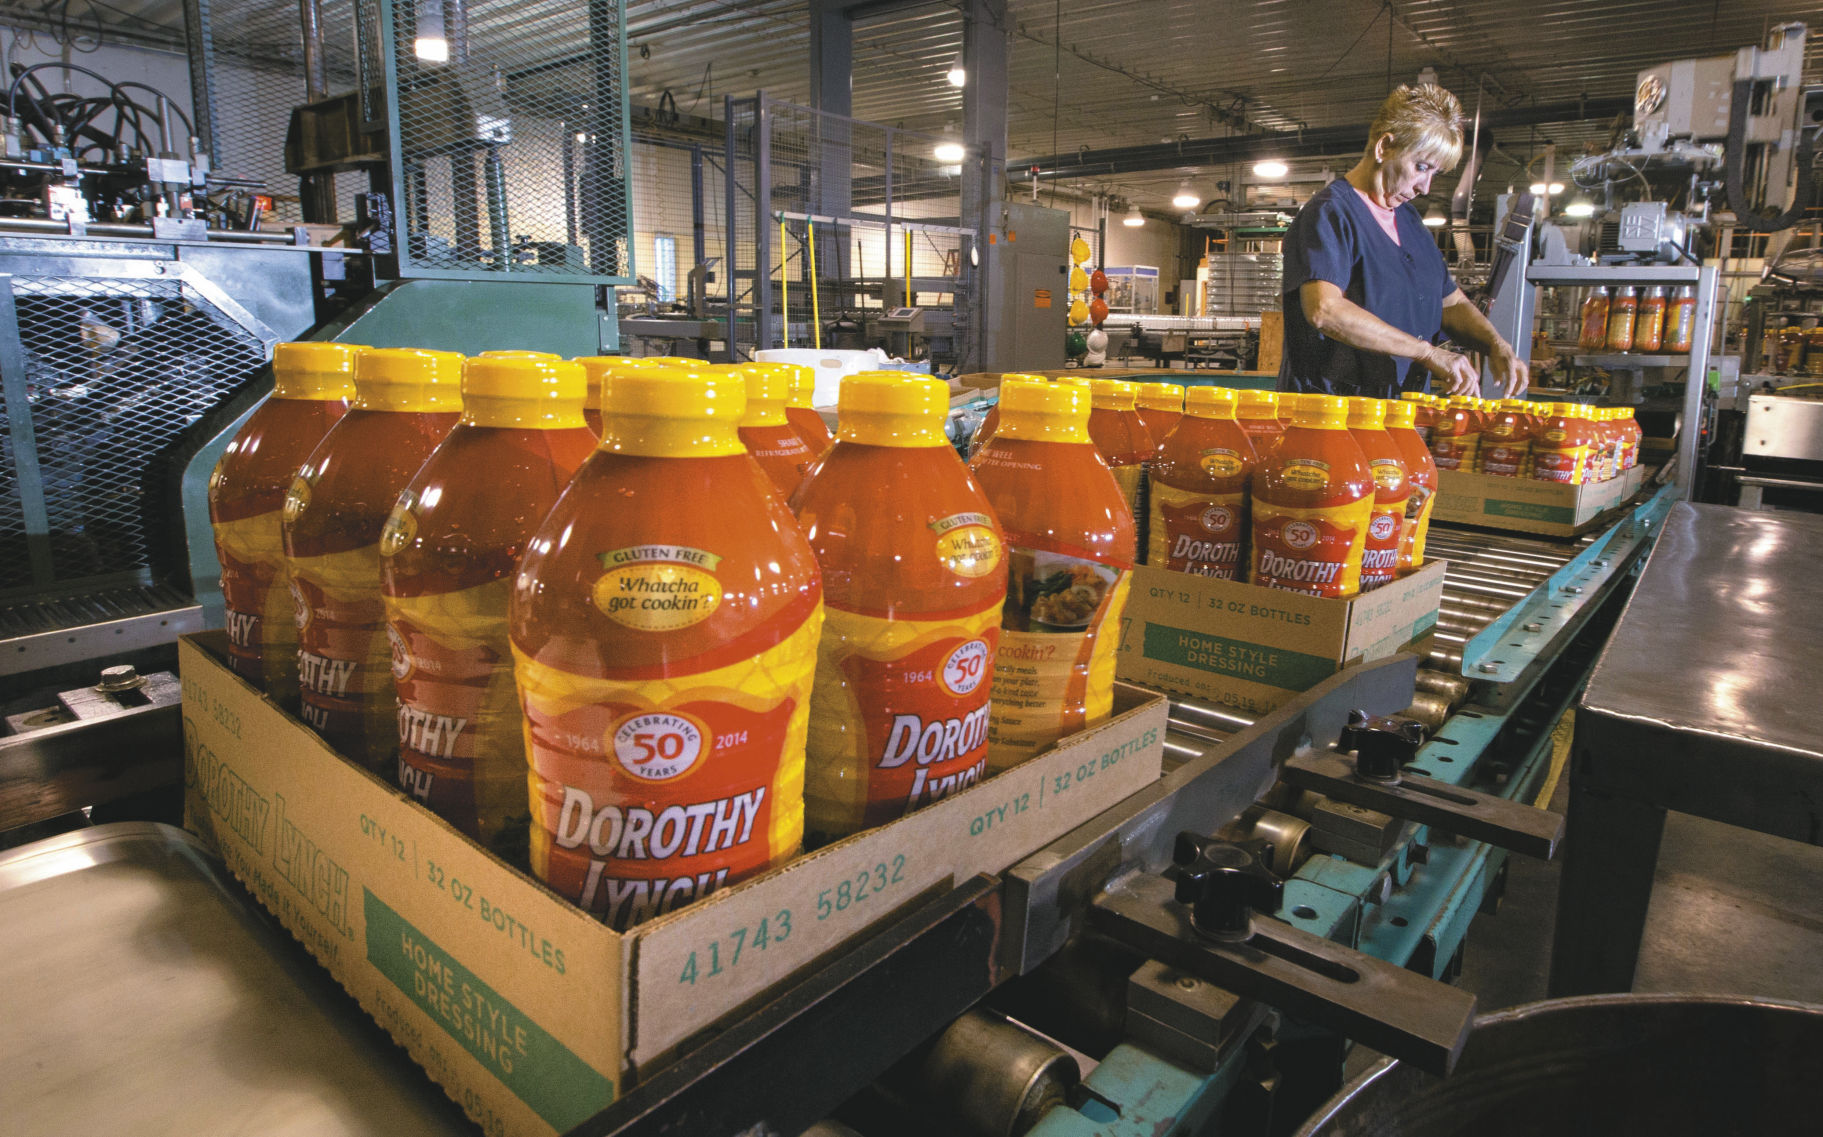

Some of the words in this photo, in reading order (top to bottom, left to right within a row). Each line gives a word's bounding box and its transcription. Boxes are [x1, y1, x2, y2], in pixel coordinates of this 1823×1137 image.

[940, 515, 973, 530] GLUTEN
[1209, 514, 1227, 526] 50
[1172, 534, 1240, 562] DOROTH
[1290, 529, 1310, 542] 50
[613, 548, 670, 563] GLUTEN
[675, 549, 706, 564] FREE
[1261, 548, 1340, 583] DOROTHY
[619, 577, 699, 593] Whatcha
[607, 596, 637, 612] got
[1150, 586, 1175, 599] QTY
[1178, 591, 1190, 603] 12
[1208, 597, 1223, 609] 32
[1228, 601, 1246, 614] OZ
[1250, 605, 1311, 626] BOTTLES
[1178, 635, 1222, 653] HOME
[1229, 643, 1278, 667] STYLE
[1187, 651, 1266, 678] DRESSING
[903, 671, 933, 684] 1964
[953, 654, 982, 685] 50
[398, 702, 467, 760] OTHY
[566, 734, 600, 752] 1964
[617, 716, 698, 744] CELEBRATING
[715, 731, 748, 750] 2014
[877, 699, 991, 768] DOROTH
[632, 732, 685, 765] 50
[640, 765, 677, 778] YEARS
[969, 803, 1009, 837] QTY
[1014, 792, 1031, 816] 12
[1052, 771, 1071, 794] 32
[1075, 758, 1098, 782] OZ
[1100, 727, 1158, 771] BOTTLES
[556, 786, 767, 860] DOROTHY
[360, 813, 387, 847] QTY
[392, 834, 406, 862] 12
[427, 860, 446, 890] 32
[450, 877, 474, 910] OZ
[479, 896, 567, 976] BOTTLES
[678, 908, 793, 986] 41743
[816, 853, 906, 921] 58232
[402, 932, 455, 997] HOME
[462, 982, 528, 1057] STYLE
[414, 969, 513, 1075] DRESSING
